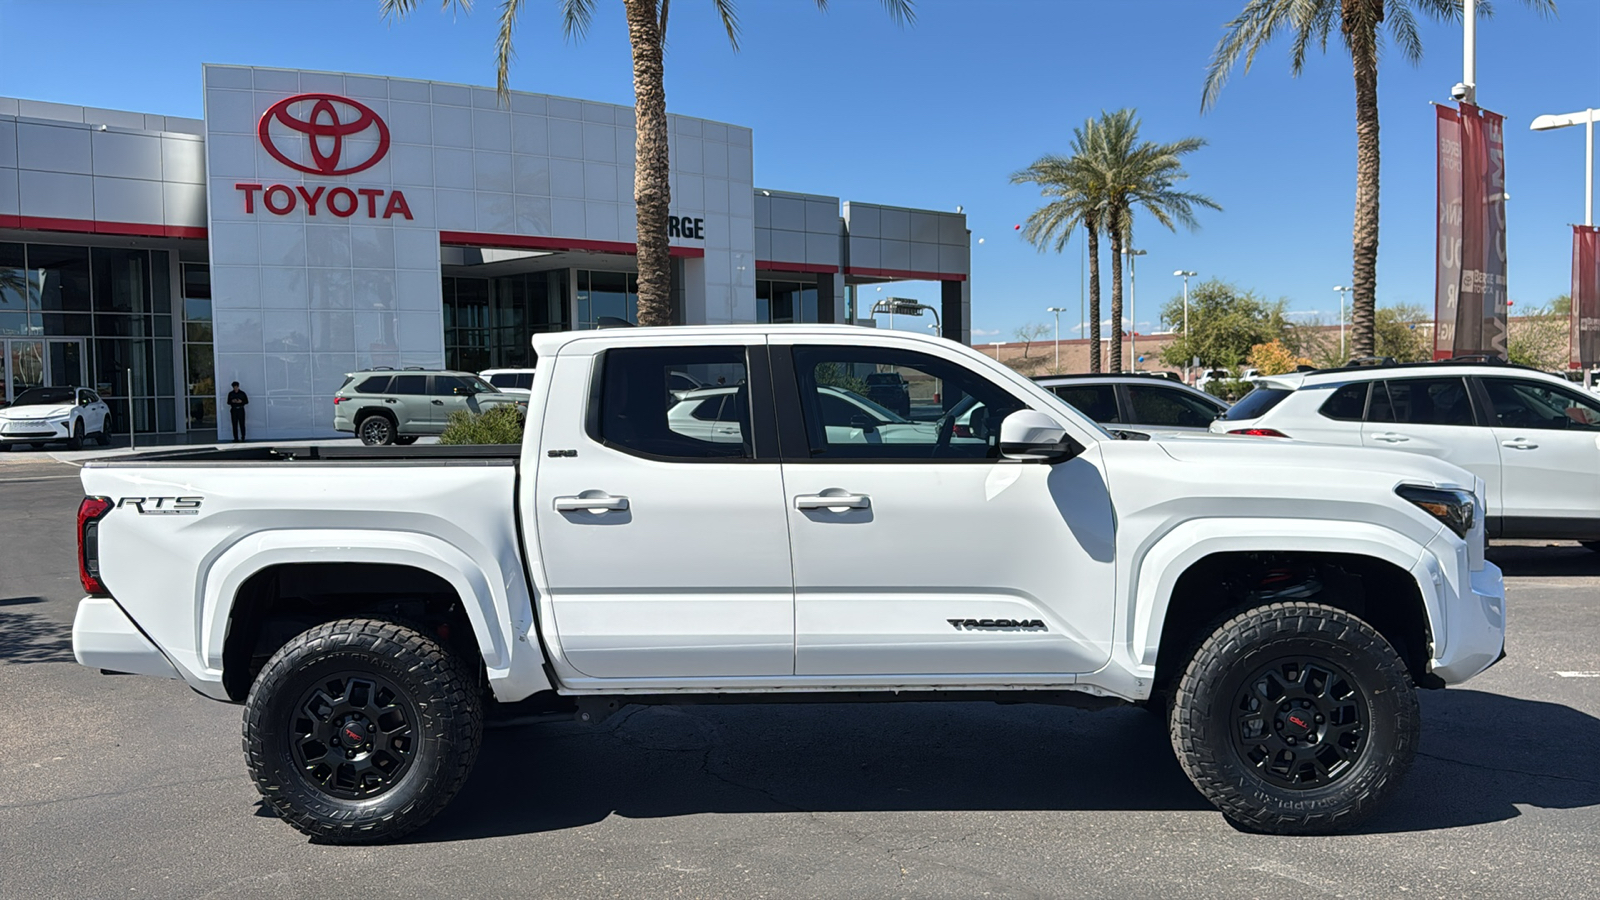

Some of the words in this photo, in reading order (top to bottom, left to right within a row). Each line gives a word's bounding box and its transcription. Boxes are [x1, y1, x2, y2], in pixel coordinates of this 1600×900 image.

[235, 183, 414, 220] TOYOTA
[668, 215, 704, 240] RGE
[116, 496, 205, 514] RTS
[946, 619, 1047, 629] TACOMA
